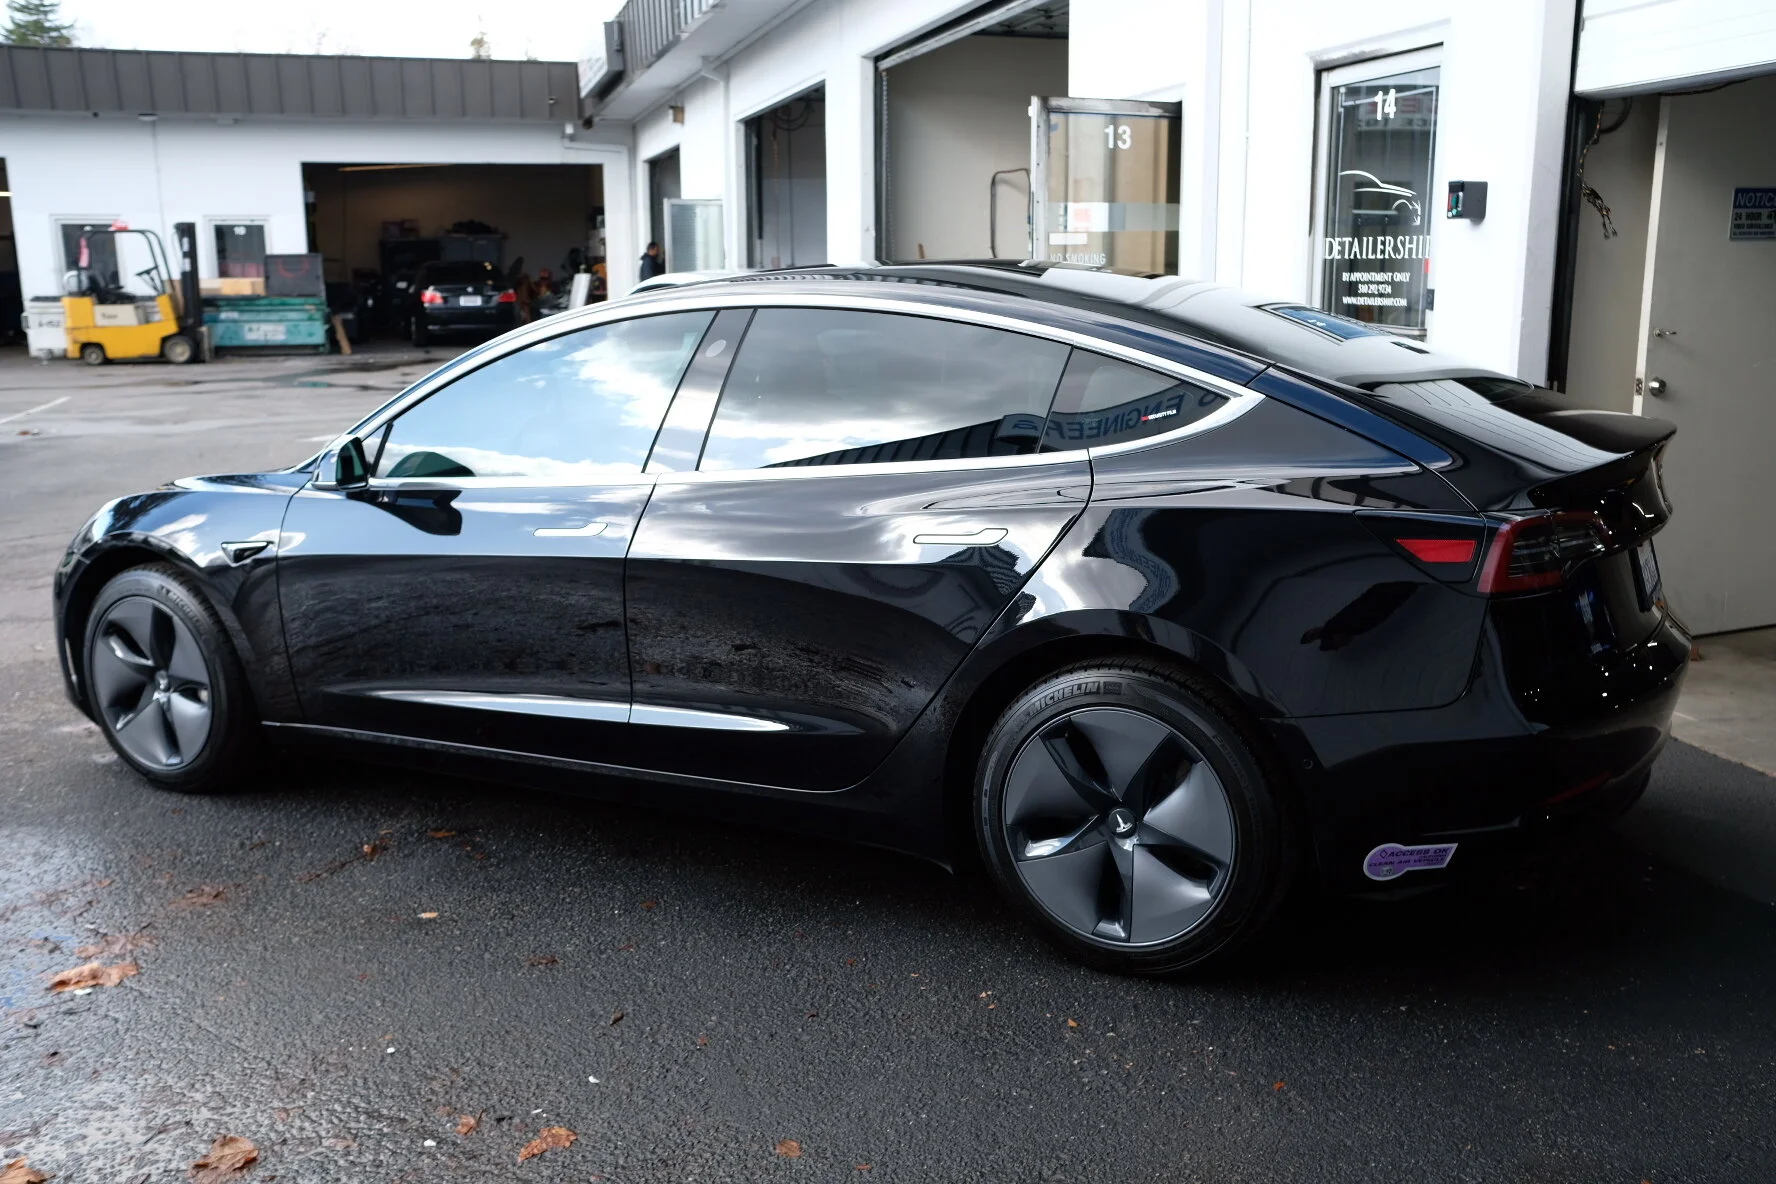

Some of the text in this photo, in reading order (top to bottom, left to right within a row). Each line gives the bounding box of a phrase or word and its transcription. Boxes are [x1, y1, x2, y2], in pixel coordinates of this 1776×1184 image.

[1374, 88, 1396, 121] 14
[1104, 124, 1131, 150] 13
[1735, 192, 1776, 207] NOTIC
[1049, 253, 1107, 265] NO SMOKING
[1342, 272, 1411, 283] BY APPOINTMENT ONLY
[1029, 682, 1100, 717] MICHELIN
[1388, 847, 1450, 858] ACCESS OK
